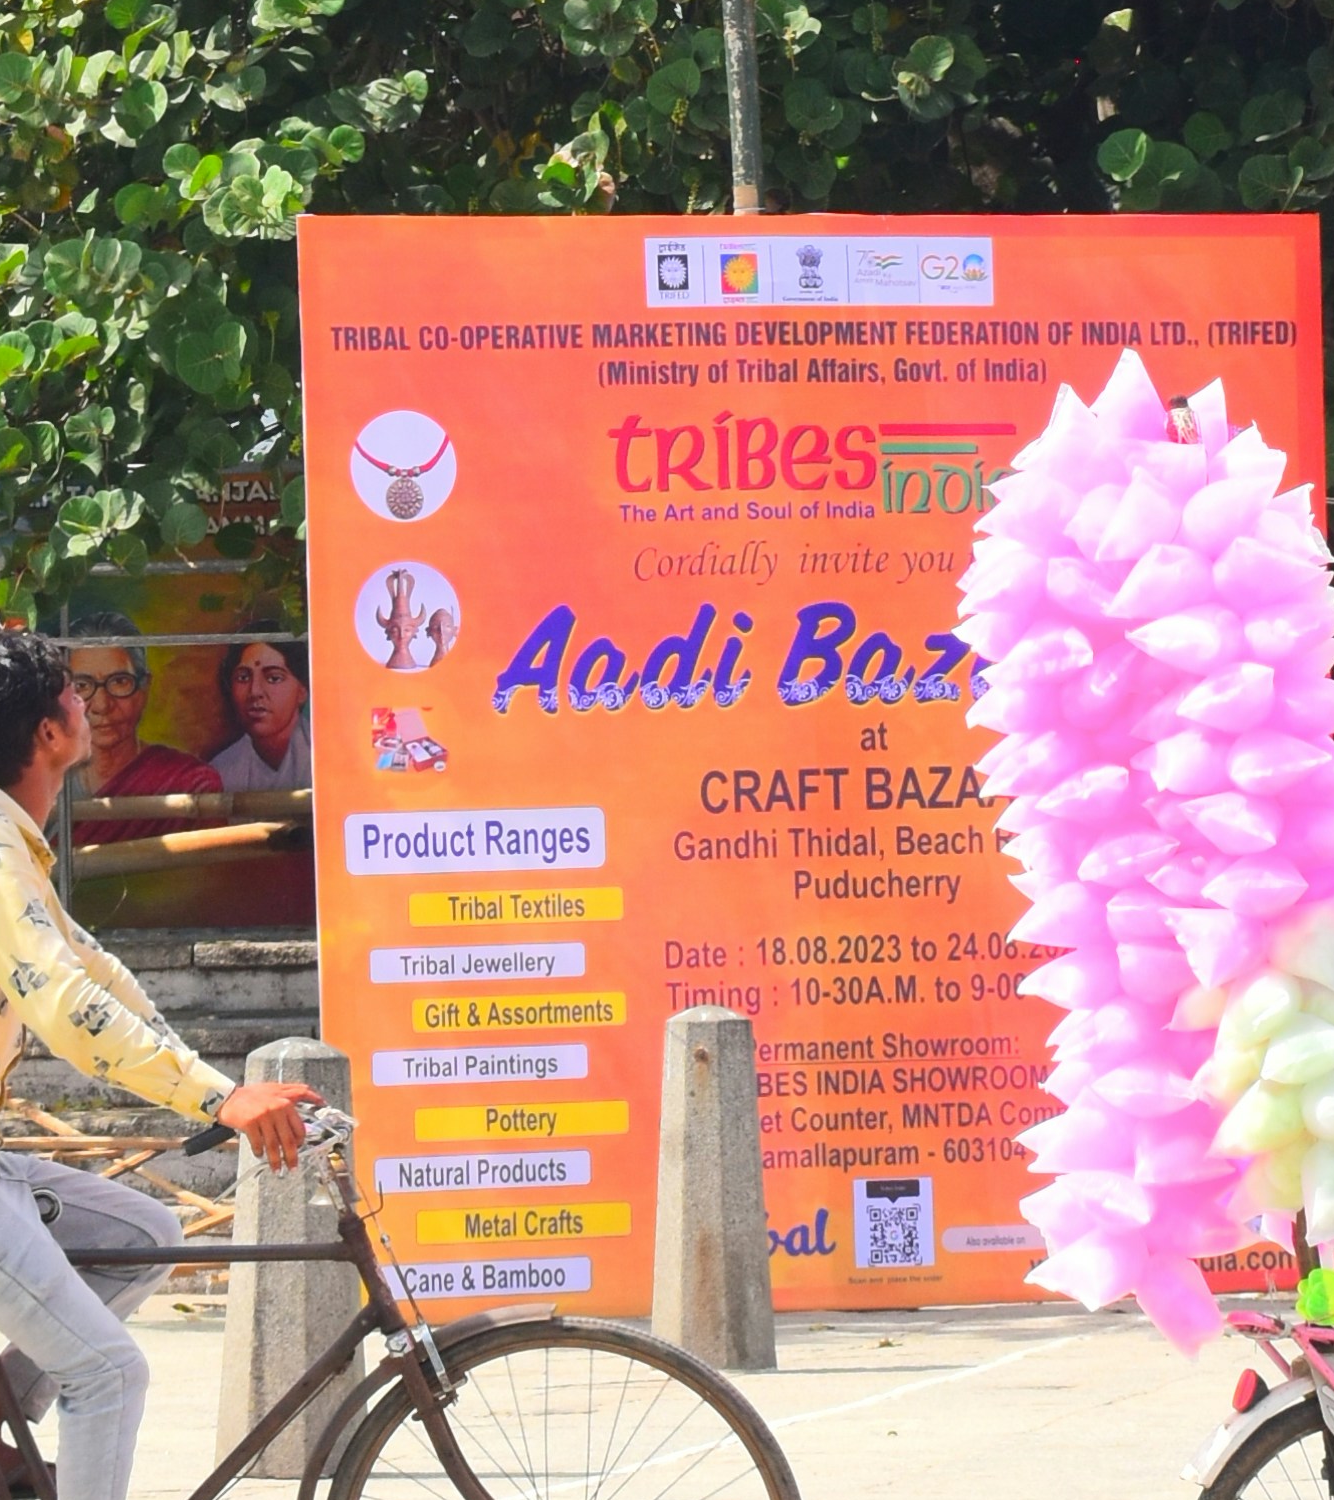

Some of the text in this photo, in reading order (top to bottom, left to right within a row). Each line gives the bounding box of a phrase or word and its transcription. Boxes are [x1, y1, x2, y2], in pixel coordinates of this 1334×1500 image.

[331, 326, 411, 352] TRIBAL
[419, 323, 583, 352] CO-OPERATIVE
[592, 321, 727, 348] MARKETING
[735, 320, 897, 347] DEVELOPMENT
[906, 320, 1042, 346] FEDERATION
[1048, 320, 1074, 346] OF
[1082, 320, 1142, 346] INDIA
[1208, 320, 1298, 347] (TRIFED)
[598, 356, 1048, 388] (Ministry of Tribal Affairs, Govt. of India)
[619, 500, 876, 523] The Art and Soul of India
[633, 540, 778, 586] Cordially
[799, 542, 889, 575] invite
[896, 547, 955, 585] you
[490, 602, 754, 714] Aadi
[860, 721, 888, 751] at
[700, 766, 1013, 815] CRAFT BAZA
[362, 820, 591, 864] Product Ranges
[673, 829, 779, 862] Gandhi
[787, 826, 886, 861] Thidal,
[896, 825, 984, 857] Beach
[794, 868, 962, 905] Puducherry
[448, 893, 585, 921] Tribal Textiles
[400, 952, 556, 977] Tribal Jewellery
[665, 939, 727, 970] Date
[755, 934, 903, 966] 18.08.2023
[910, 936, 938, 962] to
[947, 931, 1072, 961] 24.08.20
[665, 981, 762, 1015] Timing
[790, 974, 926, 1007] 10-30A.M.
[934, 976, 961, 1003] to
[424, 1000, 614, 1029] Gift & Assortments
[753, 1031, 1021, 1062] ermanent Showroom:
[403, 1054, 559, 1080] Tribal Paintings
[756, 1064, 1049, 1098] BES INDIA SHOWROOM
[485, 1107, 557, 1137] Pottery
[790, 1105, 894, 1134] Counter,
[901, 1101, 993, 1129] MNTDA
[762, 1141, 920, 1174] amallapuram
[943, 1138, 1027, 1164] 603104
[398, 1158, 568, 1188] Natural Products
[464, 1209, 584, 1239] Metal Crafts
[965, 1235, 1026, 1246] Also available on
[403, 1262, 567, 1293] Cane & Bamboo
